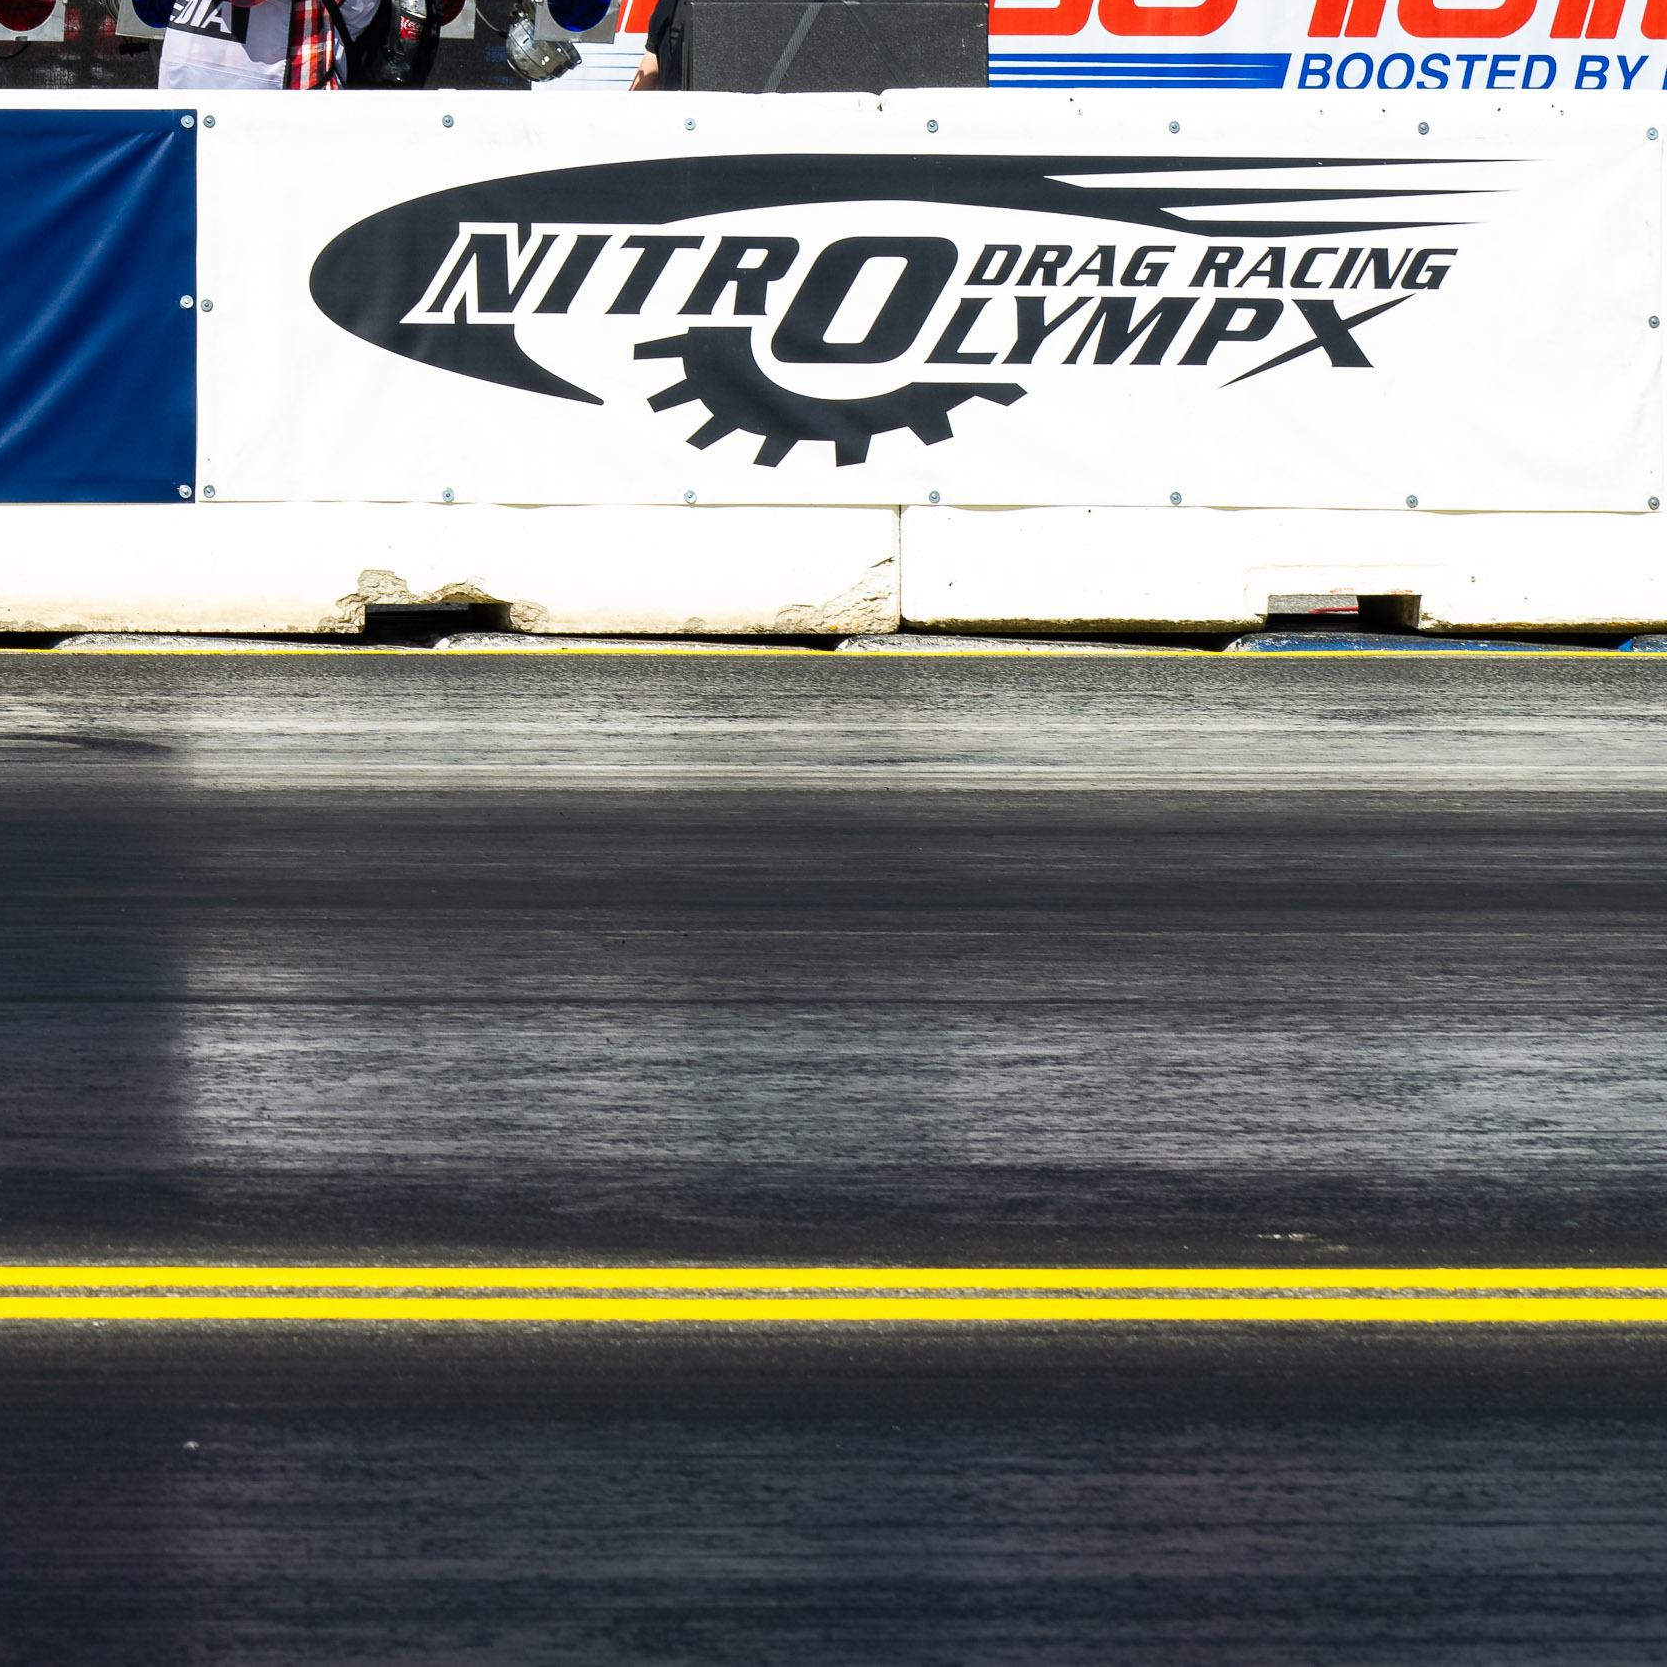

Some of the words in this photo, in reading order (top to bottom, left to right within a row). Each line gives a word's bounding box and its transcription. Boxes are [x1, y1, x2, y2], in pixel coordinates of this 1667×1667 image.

[1298, 52, 1557, 89] BOOSTED
[1574, 54, 1649, 89] BY
[965, 242, 1176, 288] DRAG
[1188, 242, 1458, 290] RACING
